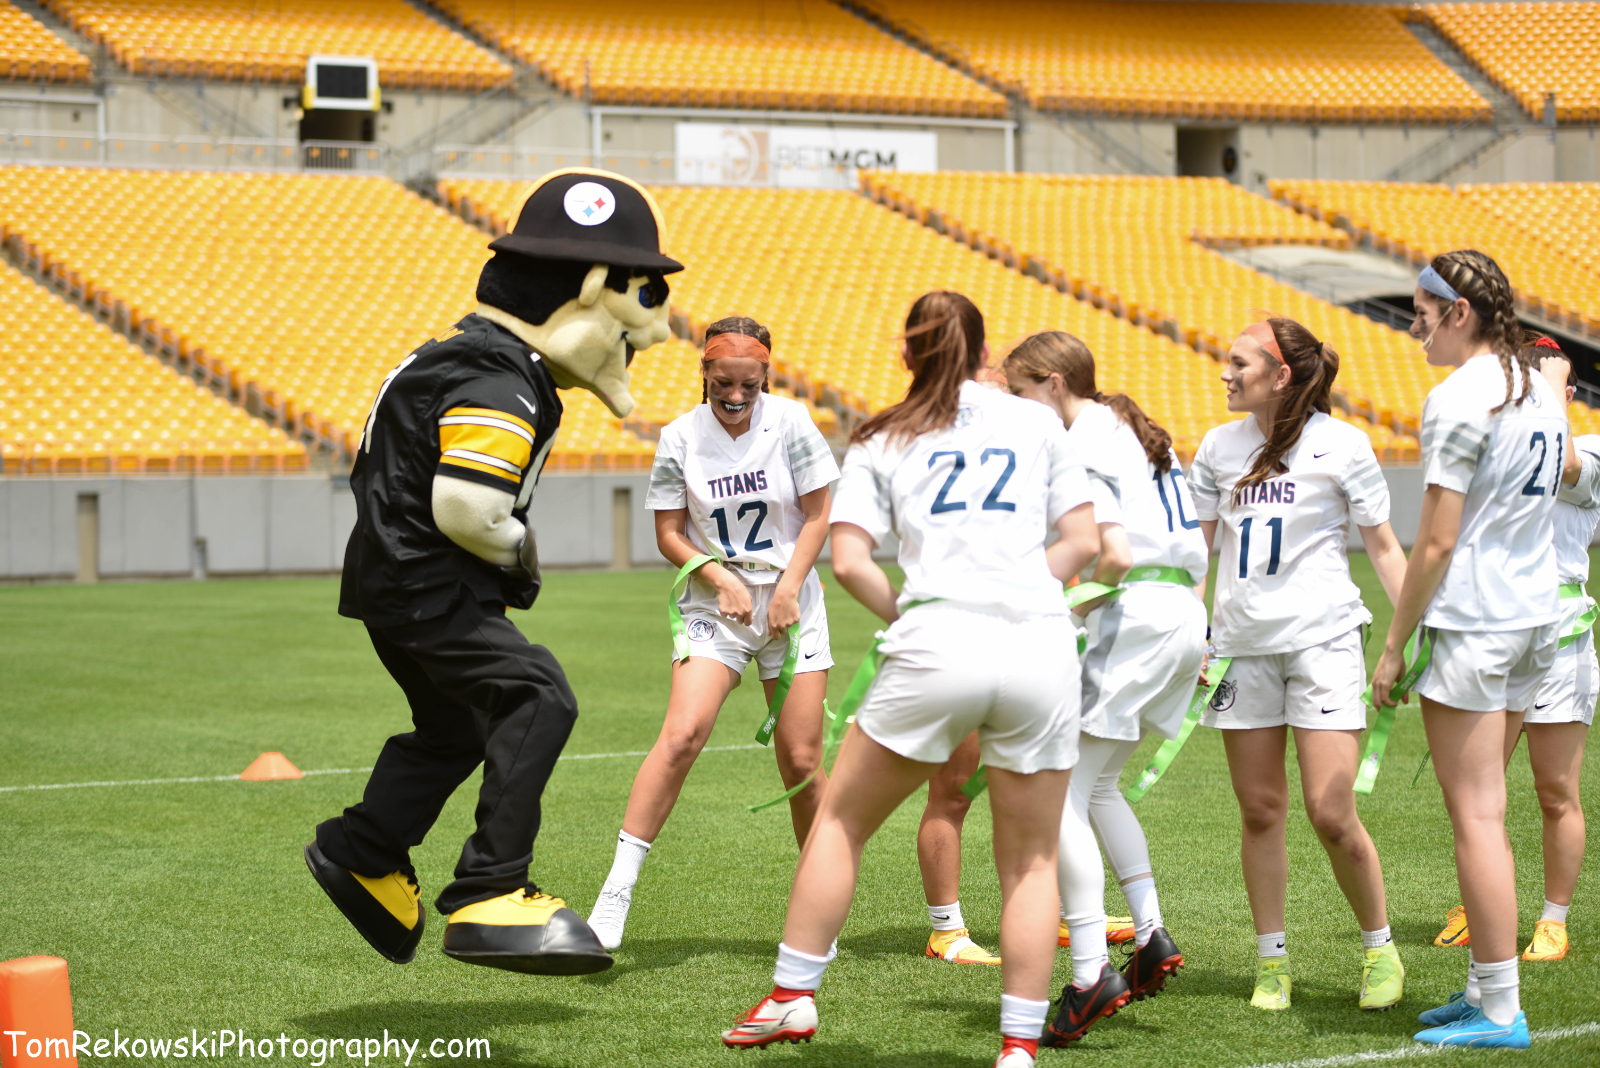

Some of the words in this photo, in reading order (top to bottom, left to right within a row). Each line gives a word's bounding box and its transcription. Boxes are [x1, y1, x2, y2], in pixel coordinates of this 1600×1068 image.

[707, 470, 768, 499] TITANS
[927, 448, 1017, 515] 22
[1521, 431, 1563, 497] 21
[709, 500, 774, 559] 12
[1237, 517, 1283, 579] 11
